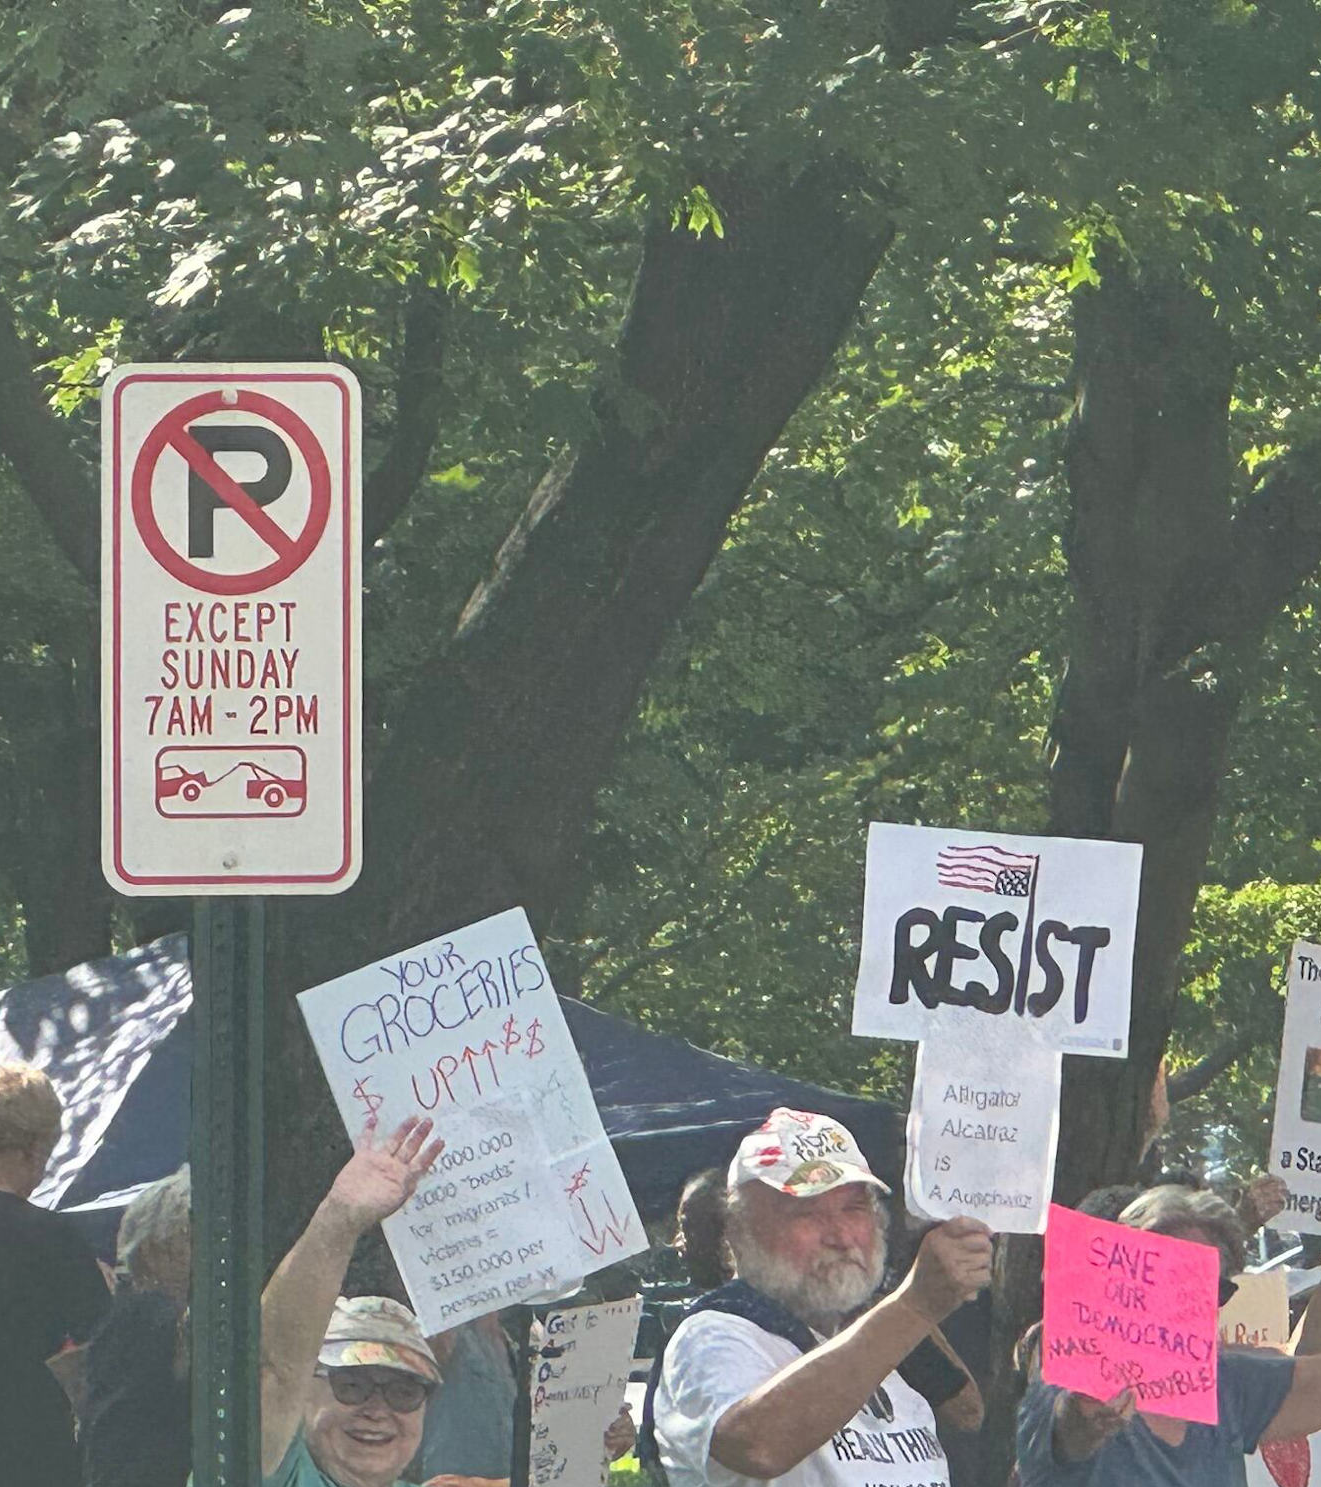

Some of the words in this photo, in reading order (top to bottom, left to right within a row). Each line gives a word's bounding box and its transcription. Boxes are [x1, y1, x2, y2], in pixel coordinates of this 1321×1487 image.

[165, 603, 296, 643] EXCEPT
[161, 649, 299, 689] SUNDAY
[145, 695, 212, 735] 7AM
[250, 695, 319, 735] 2PM
[380, 942, 465, 994] YOUR
[889, 906, 1110, 1024] RESIST
[341, 946, 544, 1063] GROCERIES
[412, 1056, 456, 1110] UP
[1281, 1151, 1291, 1169] a
[518, 1240, 544, 1263] per
[1087, 1237, 1160, 1285] SAVE
[1105, 1278, 1147, 1311] OUR
[1072, 1302, 1212, 1361] DEMOCRACY
